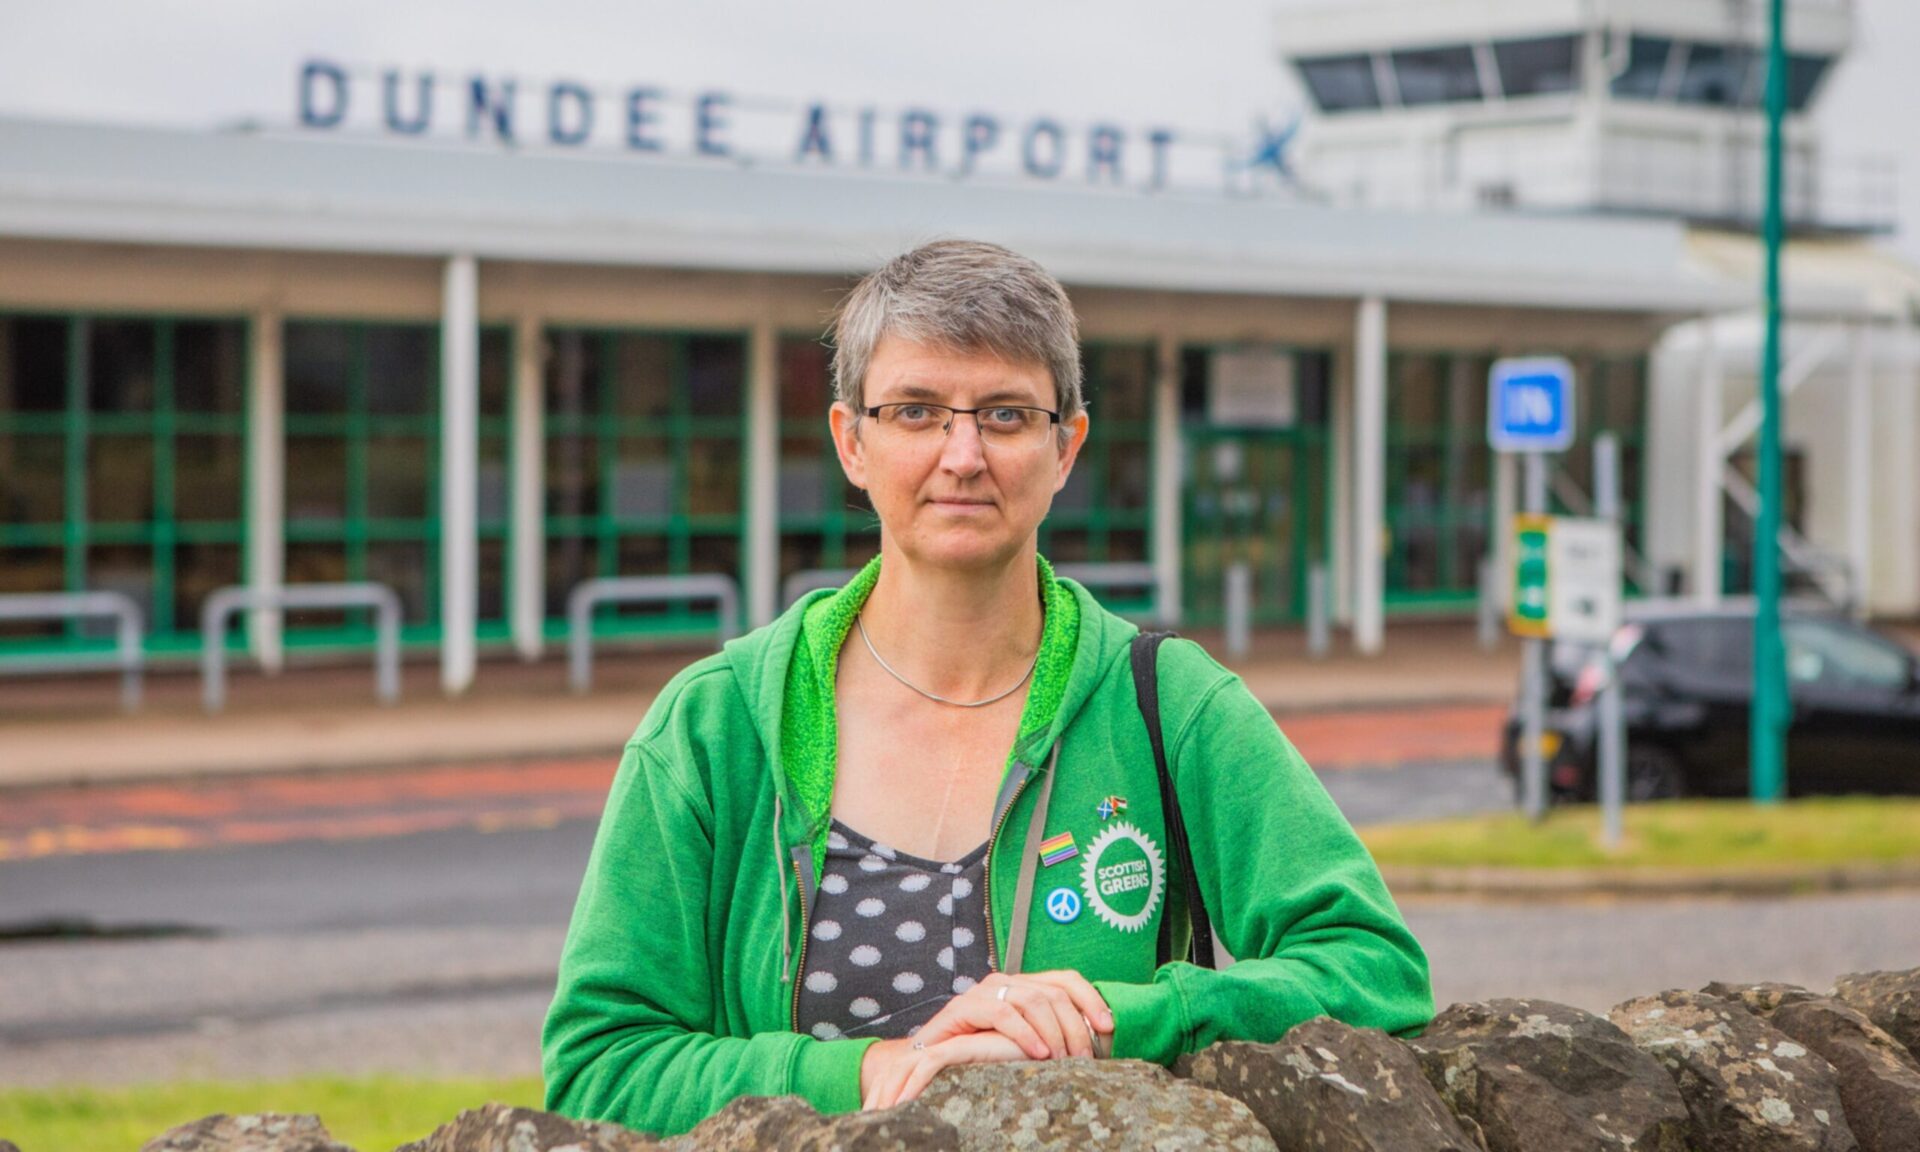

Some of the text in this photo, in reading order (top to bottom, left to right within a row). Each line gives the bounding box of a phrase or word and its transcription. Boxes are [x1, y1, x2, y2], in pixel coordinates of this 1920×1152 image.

[298, 58, 1174, 190] DUNDEE AIRPORT
[1504, 384, 1553, 426] IN
[1098, 860, 1147, 879] SCOTTISH
[1101, 873, 1149, 895] GREENS
